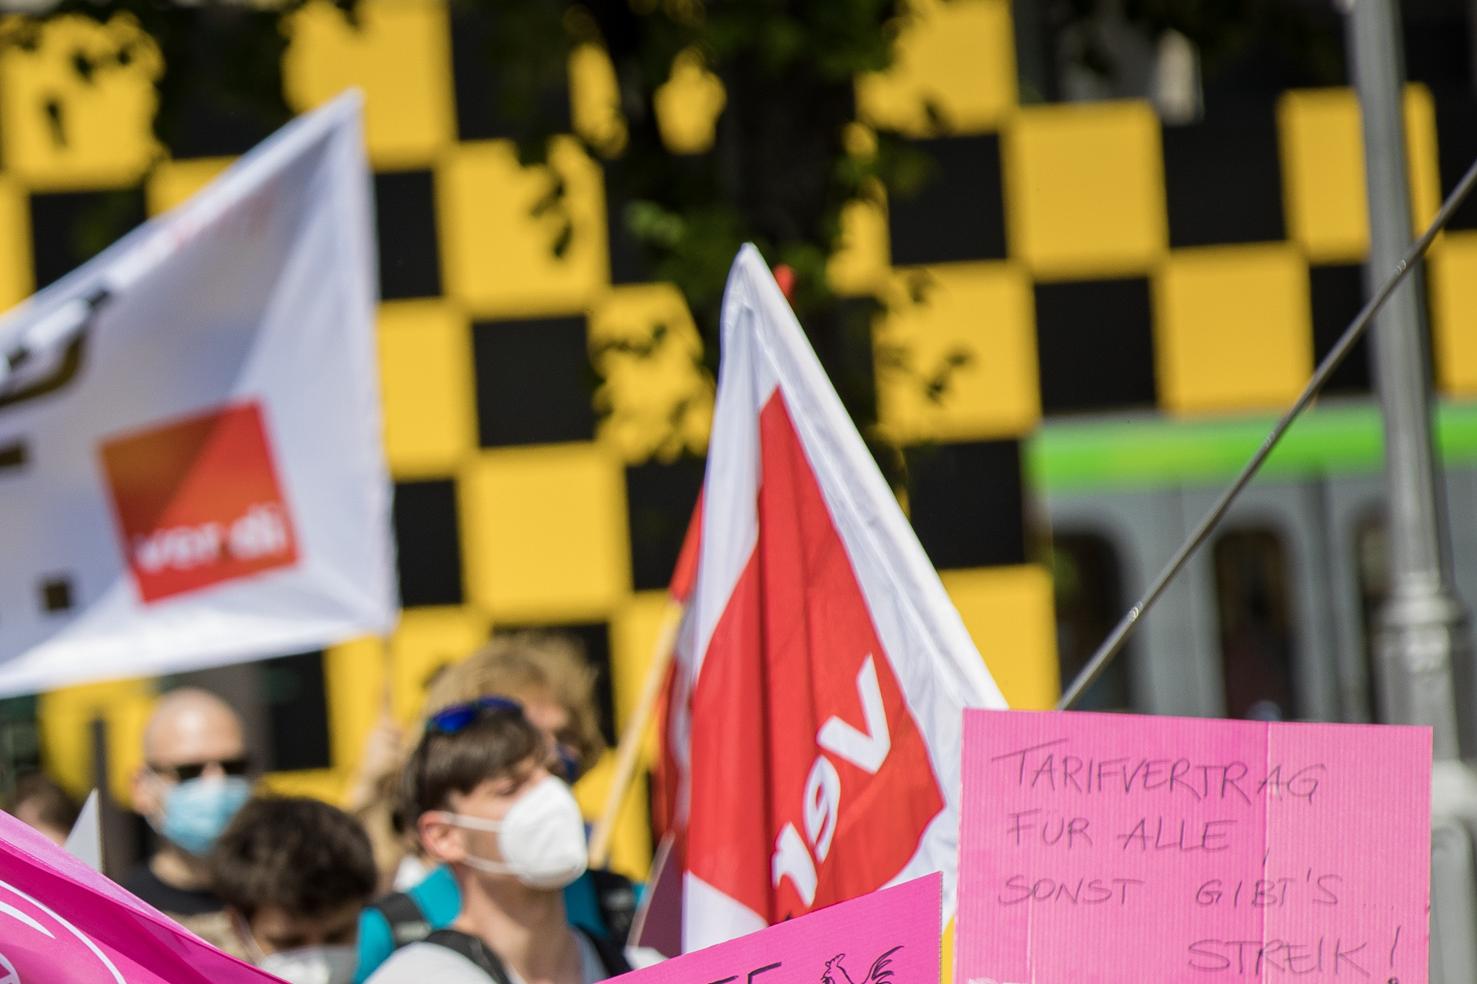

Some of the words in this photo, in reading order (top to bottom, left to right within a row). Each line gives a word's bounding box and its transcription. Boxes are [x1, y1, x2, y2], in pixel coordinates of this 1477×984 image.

[990, 737, 1328, 806] TARIFVERTRAG
[1116, 816, 1239, 852] ALLE
[998, 875, 1146, 907] SONST
